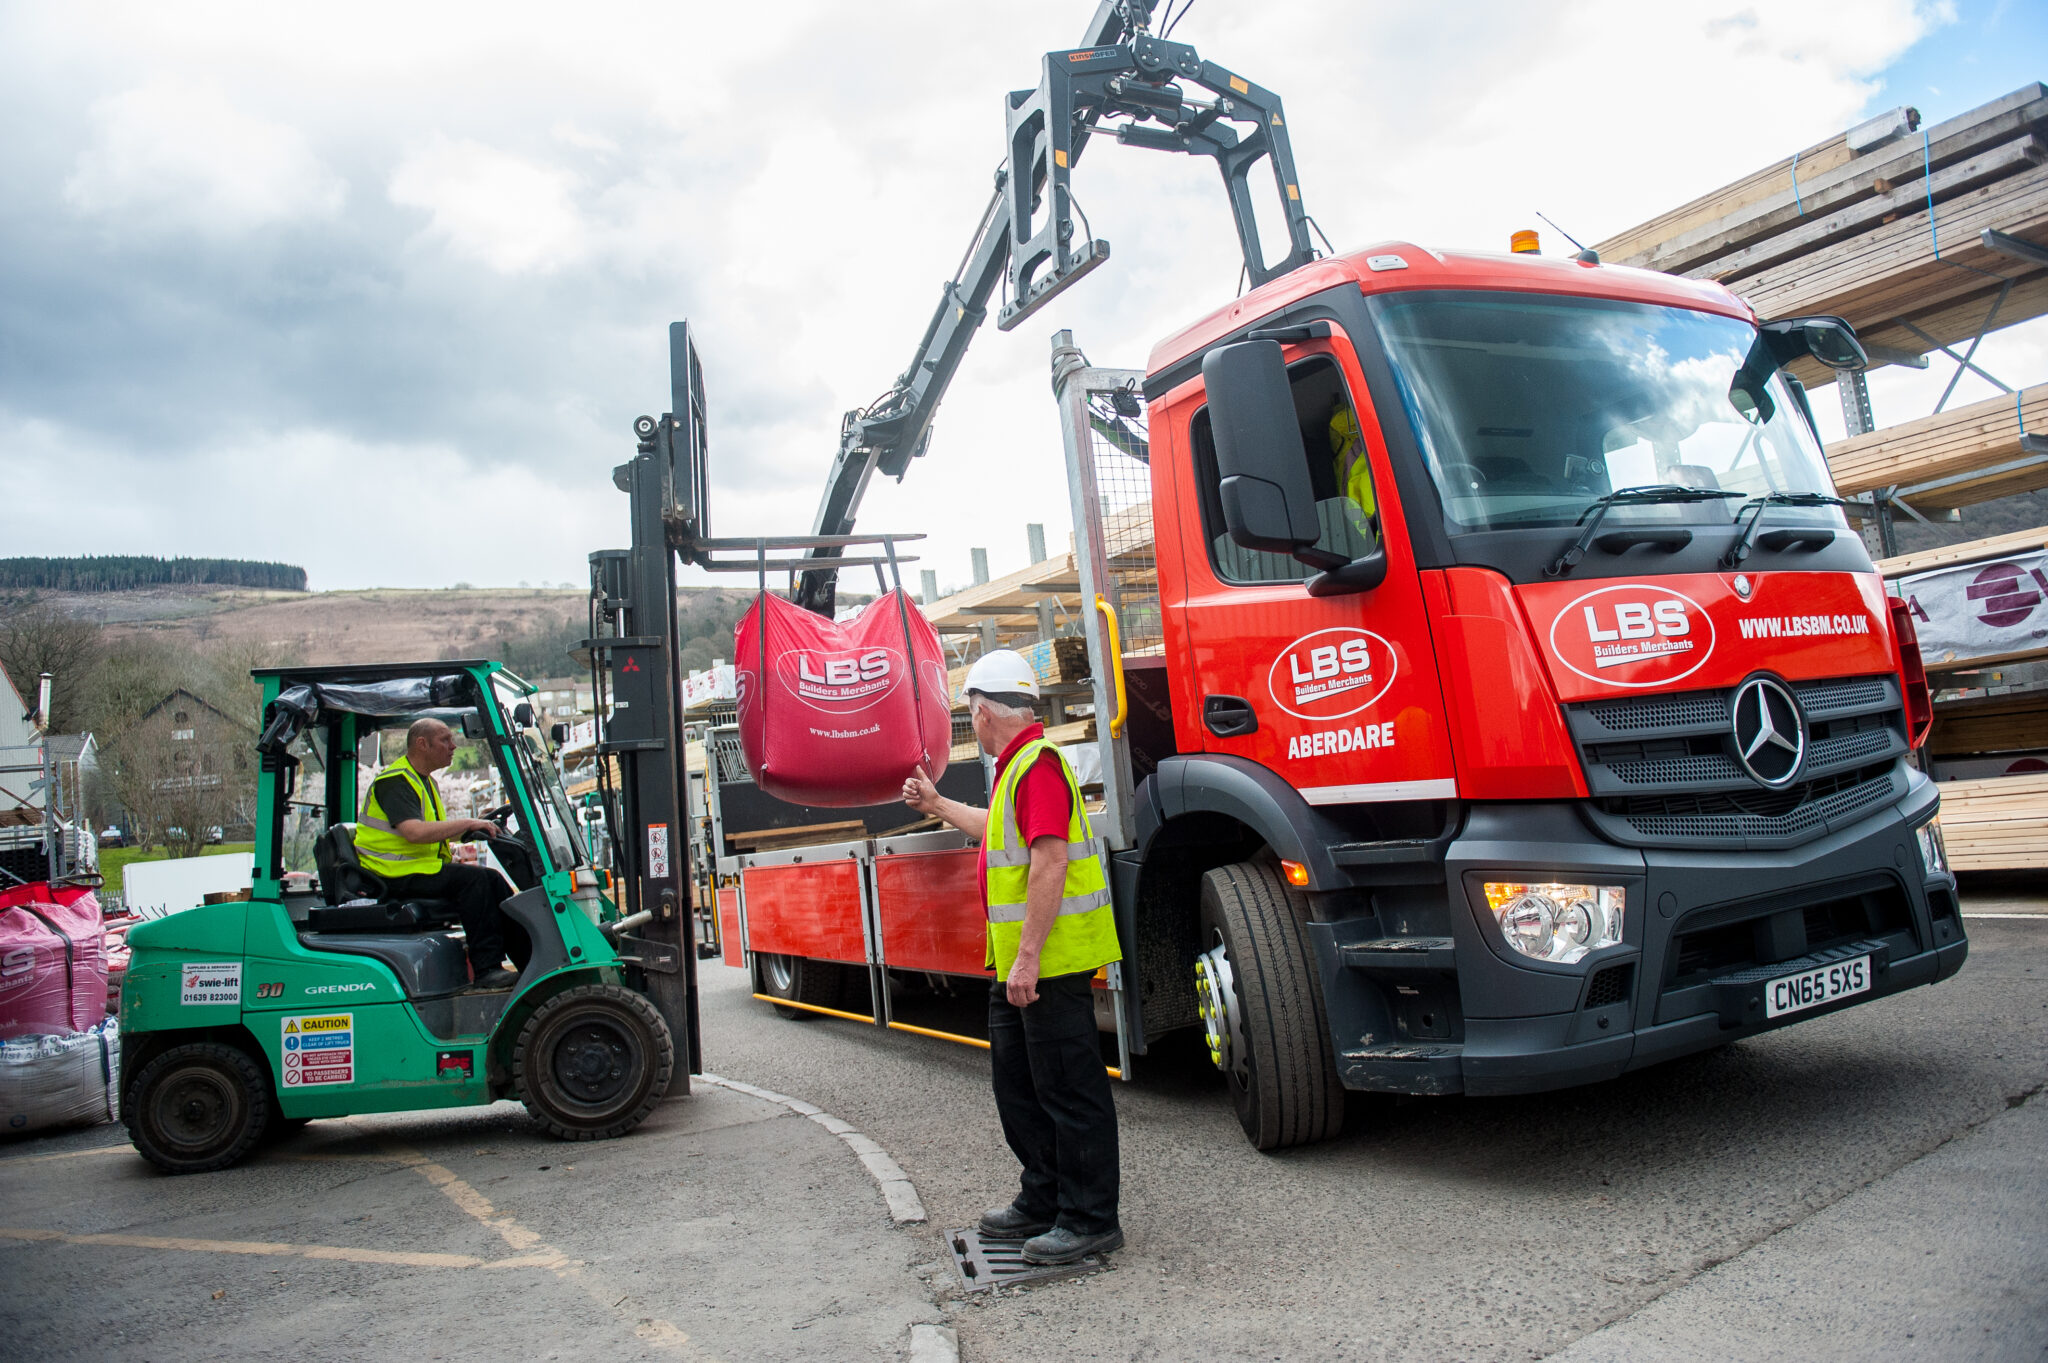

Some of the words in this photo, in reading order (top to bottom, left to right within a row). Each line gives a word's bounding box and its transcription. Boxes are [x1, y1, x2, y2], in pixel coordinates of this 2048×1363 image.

[1583, 600, 1691, 643] LBS
[1738, 614, 1869, 639] WWW.LBSBM.CO.UK
[1593, 645, 1638, 657] Builders
[1640, 639, 1694, 653] Merchants
[798, 650, 891, 686] LBS
[1289, 638, 1371, 684] LBS
[799, 681, 838, 696] Builders
[840, 678, 890, 696] Merchants
[1294, 683, 1327, 696] Builders
[1327, 674, 1373, 689] Merchants
[809, 723, 881, 739] www.lbsbm.co.uk
[1287, 721, 1395, 760] ABERDARE
[198, 977, 239, 987] swie-lift
[256, 982, 285, 998] 30
[1775, 972, 1825, 1011] CN65
[1829, 961, 1863, 995] SXS
[183, 993, 208, 1002] 01639
[209, 993, 238, 1001] 823000
[303, 1018, 349, 1030] CAUTION
